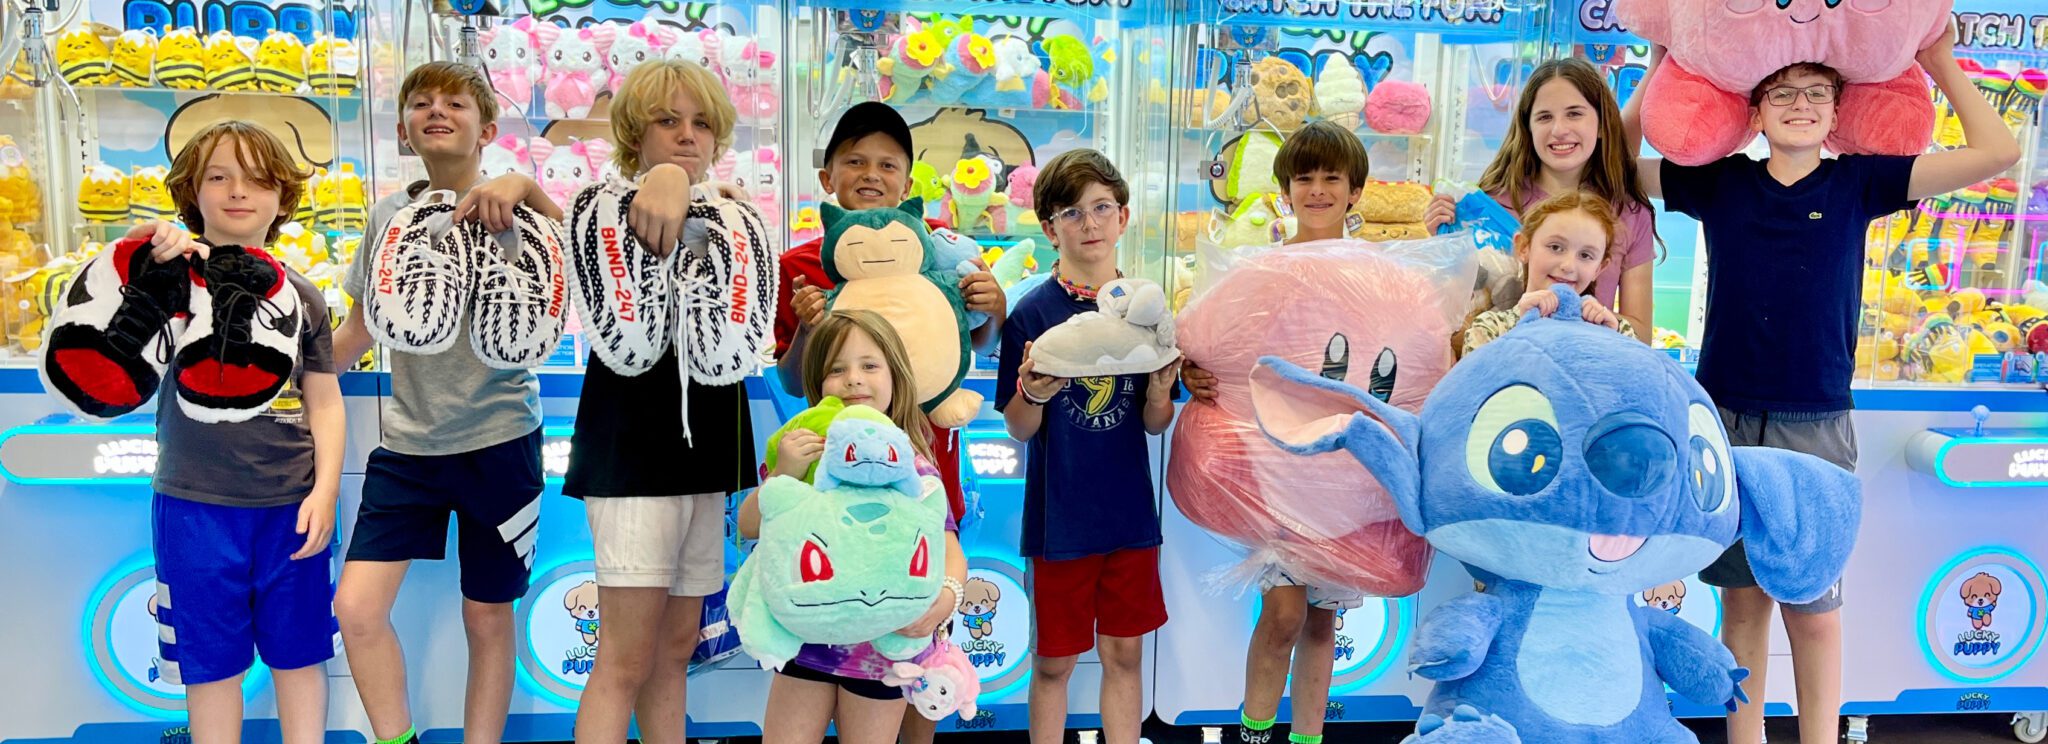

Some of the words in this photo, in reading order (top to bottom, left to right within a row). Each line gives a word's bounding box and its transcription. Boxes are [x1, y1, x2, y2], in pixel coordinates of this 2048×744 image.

[547, 235, 564, 318] BNND-247
[600, 227, 635, 322] BNND-247
[730, 230, 749, 324] BNND-247
[1123, 379, 1134, 391] 16
[1060, 395, 1130, 428] BANANAS
[1958, 630, 2000, 642] LUCKY
[565, 645, 598, 661] LUC
[961, 640, 1004, 653] UCKY
[1954, 642, 2000, 656] PUPPY
[1960, 692, 1990, 701] LUCKY
[1956, 700, 1991, 711] PUPPY
